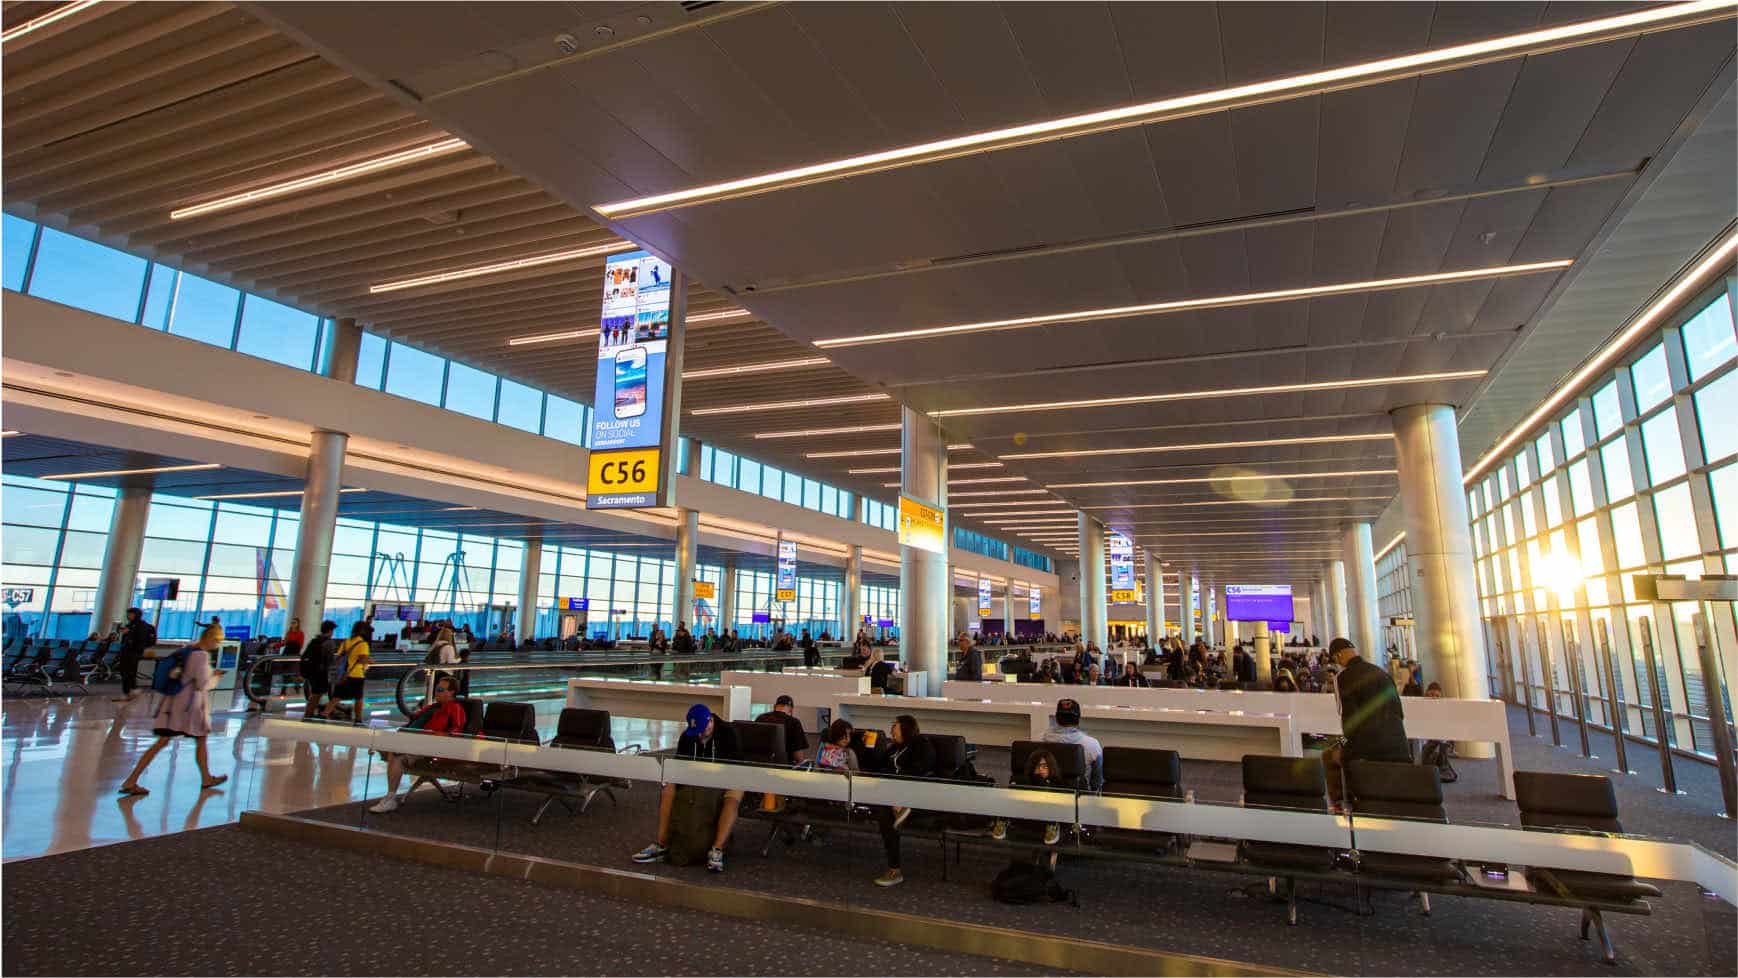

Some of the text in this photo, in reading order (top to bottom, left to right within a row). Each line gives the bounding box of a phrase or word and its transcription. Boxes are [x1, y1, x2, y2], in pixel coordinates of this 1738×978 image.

[596, 419, 641, 430] FOLLOW US
[595, 429, 637, 440] ON SOCIAL
[600, 460, 646, 485] C56
[597, 495, 646, 505] Sacramento
